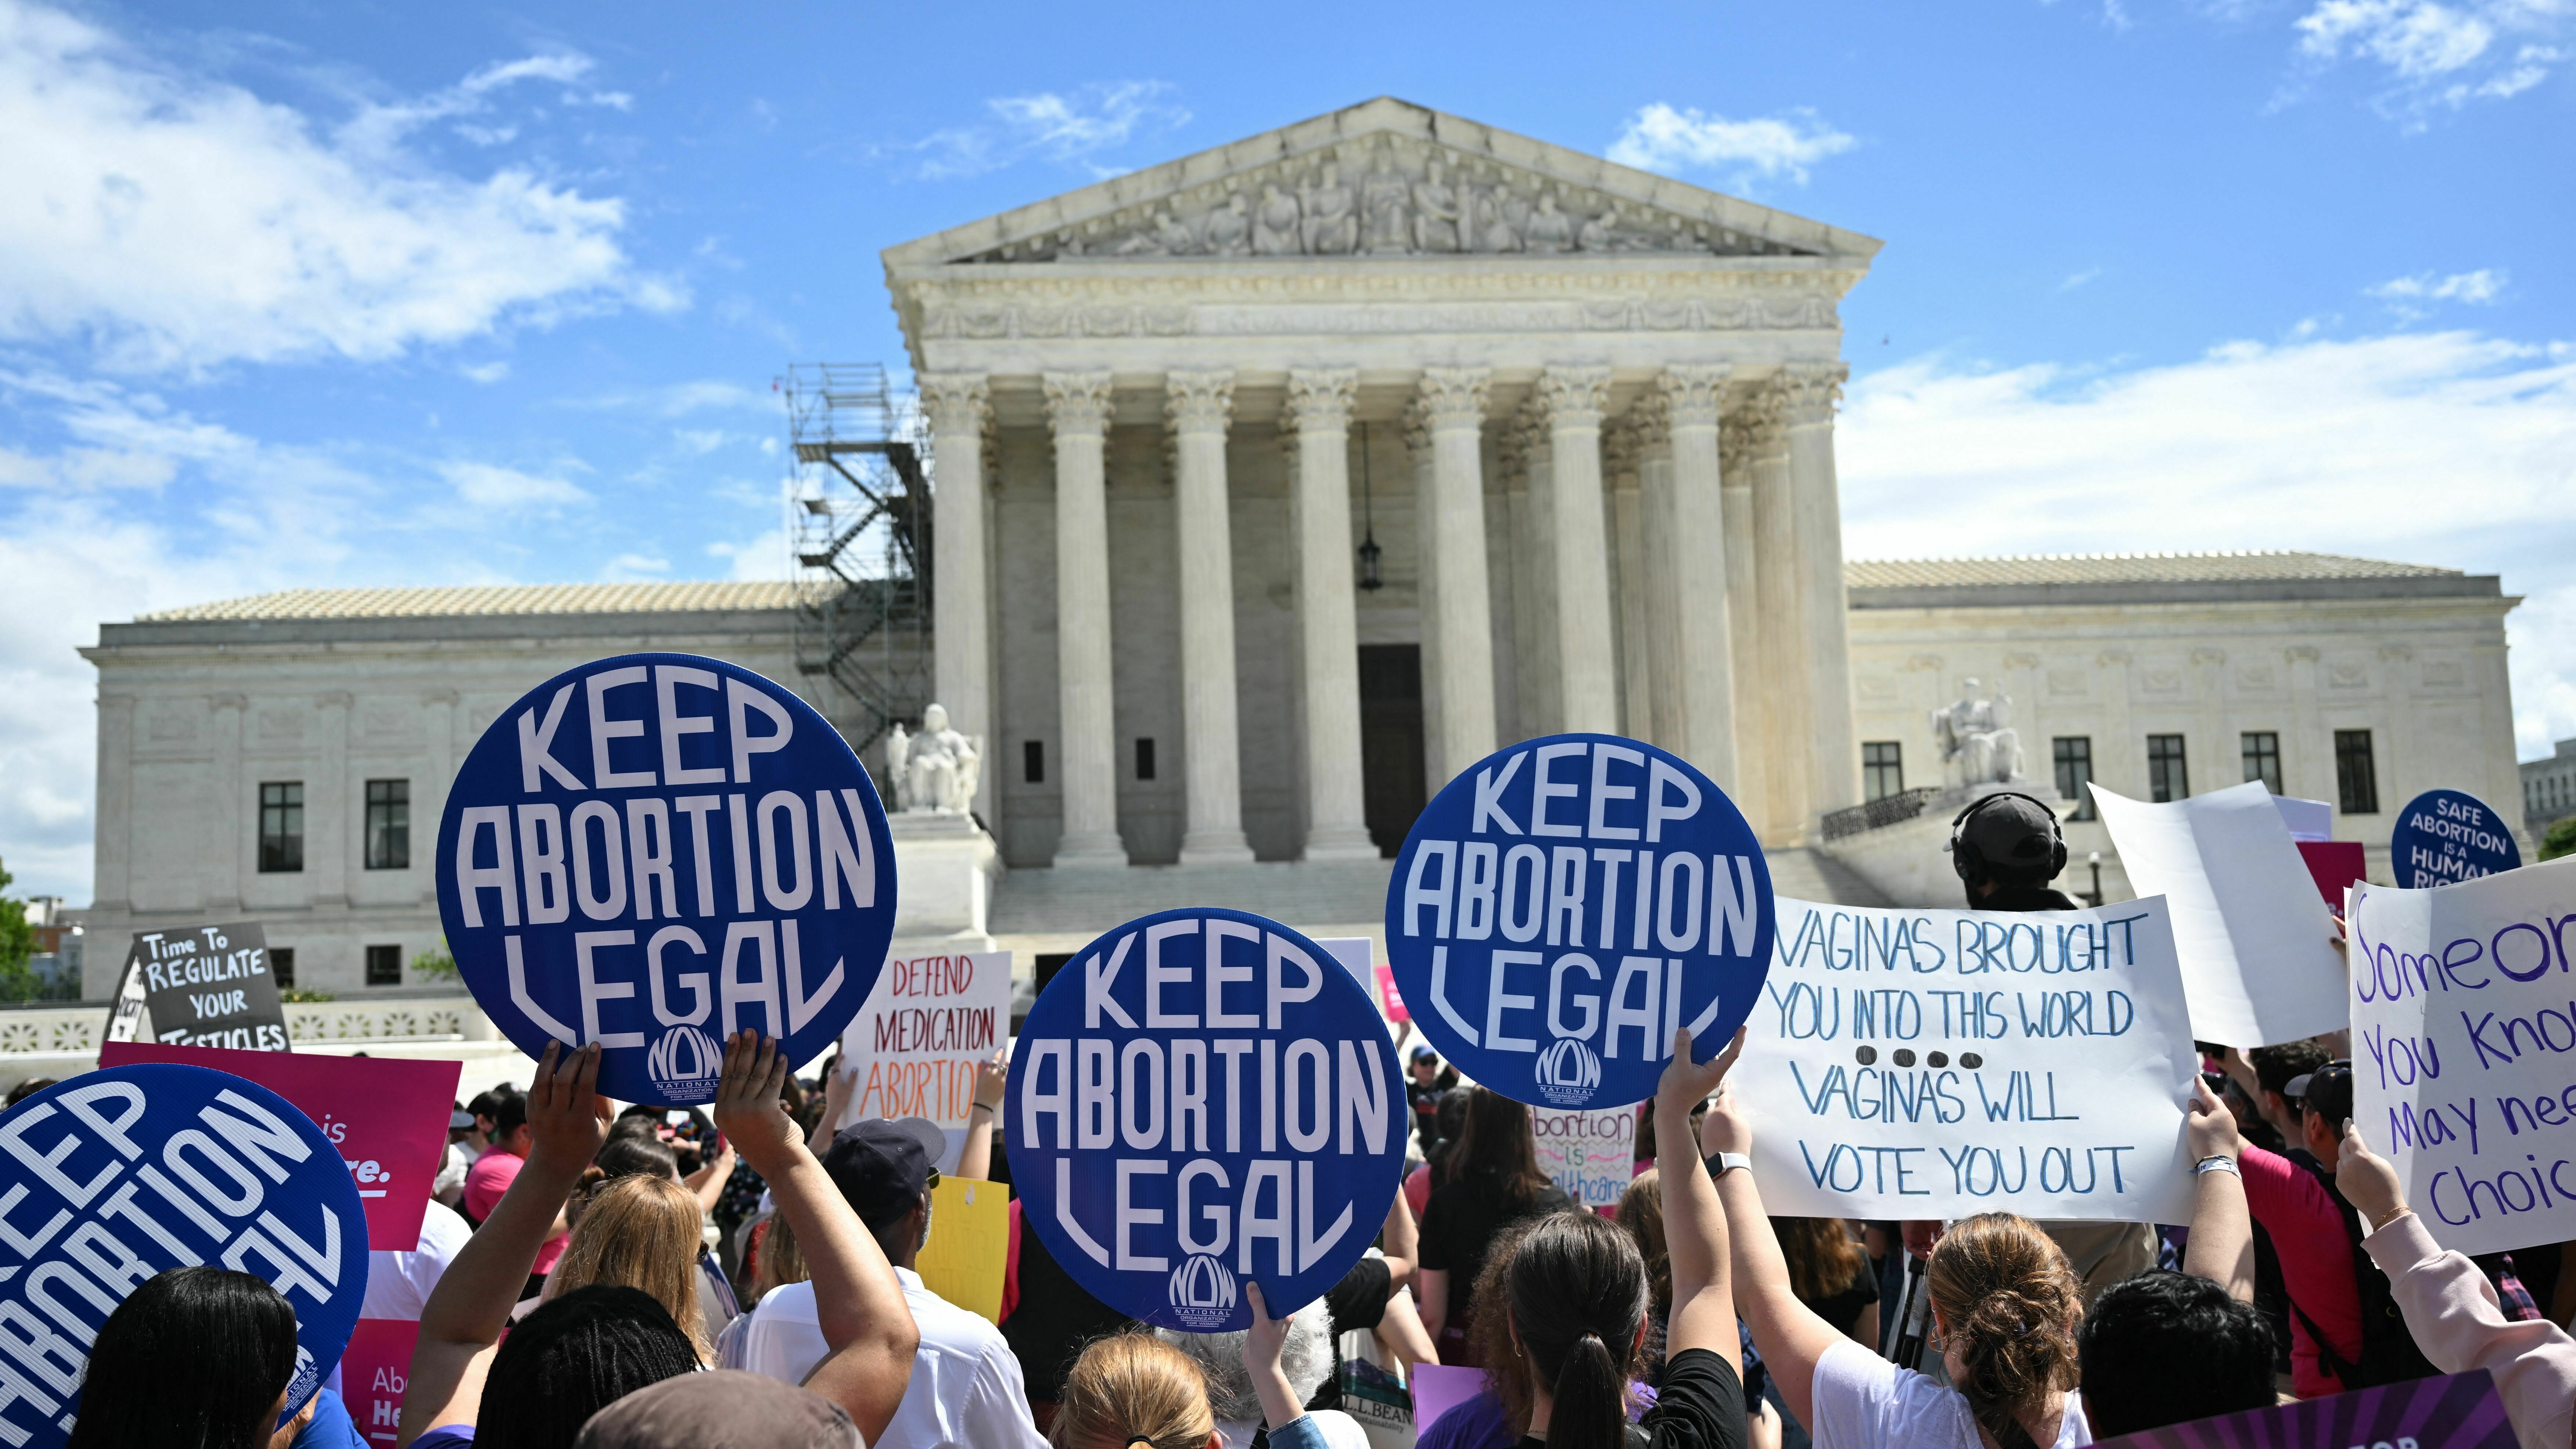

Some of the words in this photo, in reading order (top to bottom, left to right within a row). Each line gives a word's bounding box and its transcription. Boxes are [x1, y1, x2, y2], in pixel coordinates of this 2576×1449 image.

[518, 666, 793, 792] KEEP
[1473, 743, 1702, 842] KEEP
[2437, 798, 2482, 826] SAFE
[457, 789, 875, 927] ABORTION
[2410, 812, 2507, 856] ABORTION
[2444, 842, 2455, 855] IS
[2457, 846, 2467, 859] A
[1404, 840, 1757, 957] ABORTION
[142, 933, 197, 960] Time
[201, 927, 228, 951] To
[1775, 909, 1946, 973] VAGINAS
[1957, 913, 2149, 974] BROUGHT
[145, 948, 266, 992] REGULATE
[505, 919, 844, 1048] LEGAL
[894, 955, 973, 997] DEFEND
[1086, 919, 1323, 1029] KEEP
[189, 989, 249, 1019] YOUR
[874, 1006, 995, 1052] MEDICATION
[1430, 946, 1718, 1061] LEGAL
[1766, 980, 1839, 1040] YOU
[1853, 989, 1921, 1040] INTO
[1927, 991, 2008, 1039] THIS
[2017, 990, 2134, 1039] WORLD
[648, 1027, 723, 1081] NOW
[1535, 1040, 1601, 1088] NOW
[657, 1081, 718, 1089] NATIONAL
[859, 1059, 982, 1120] ABORTIO
[1022, 1039, 1388, 1155] ABORTION
[1540, 1086, 1594, 1095] NATIONAL
[1790, 1061, 1965, 1123] VAGINAS
[1975, 1071, 2079, 1122] WILL
[1798, 1140, 1930, 1195] VOTE
[1939, 1145, 2027, 1197] YOU
[2040, 1146, 2134, 1194] OUT
[1056, 1158, 1352, 1276] LEGAL
[1170, 1256, 1236, 1308] NOW
[300, 1381, 317, 1398] WOMEN
